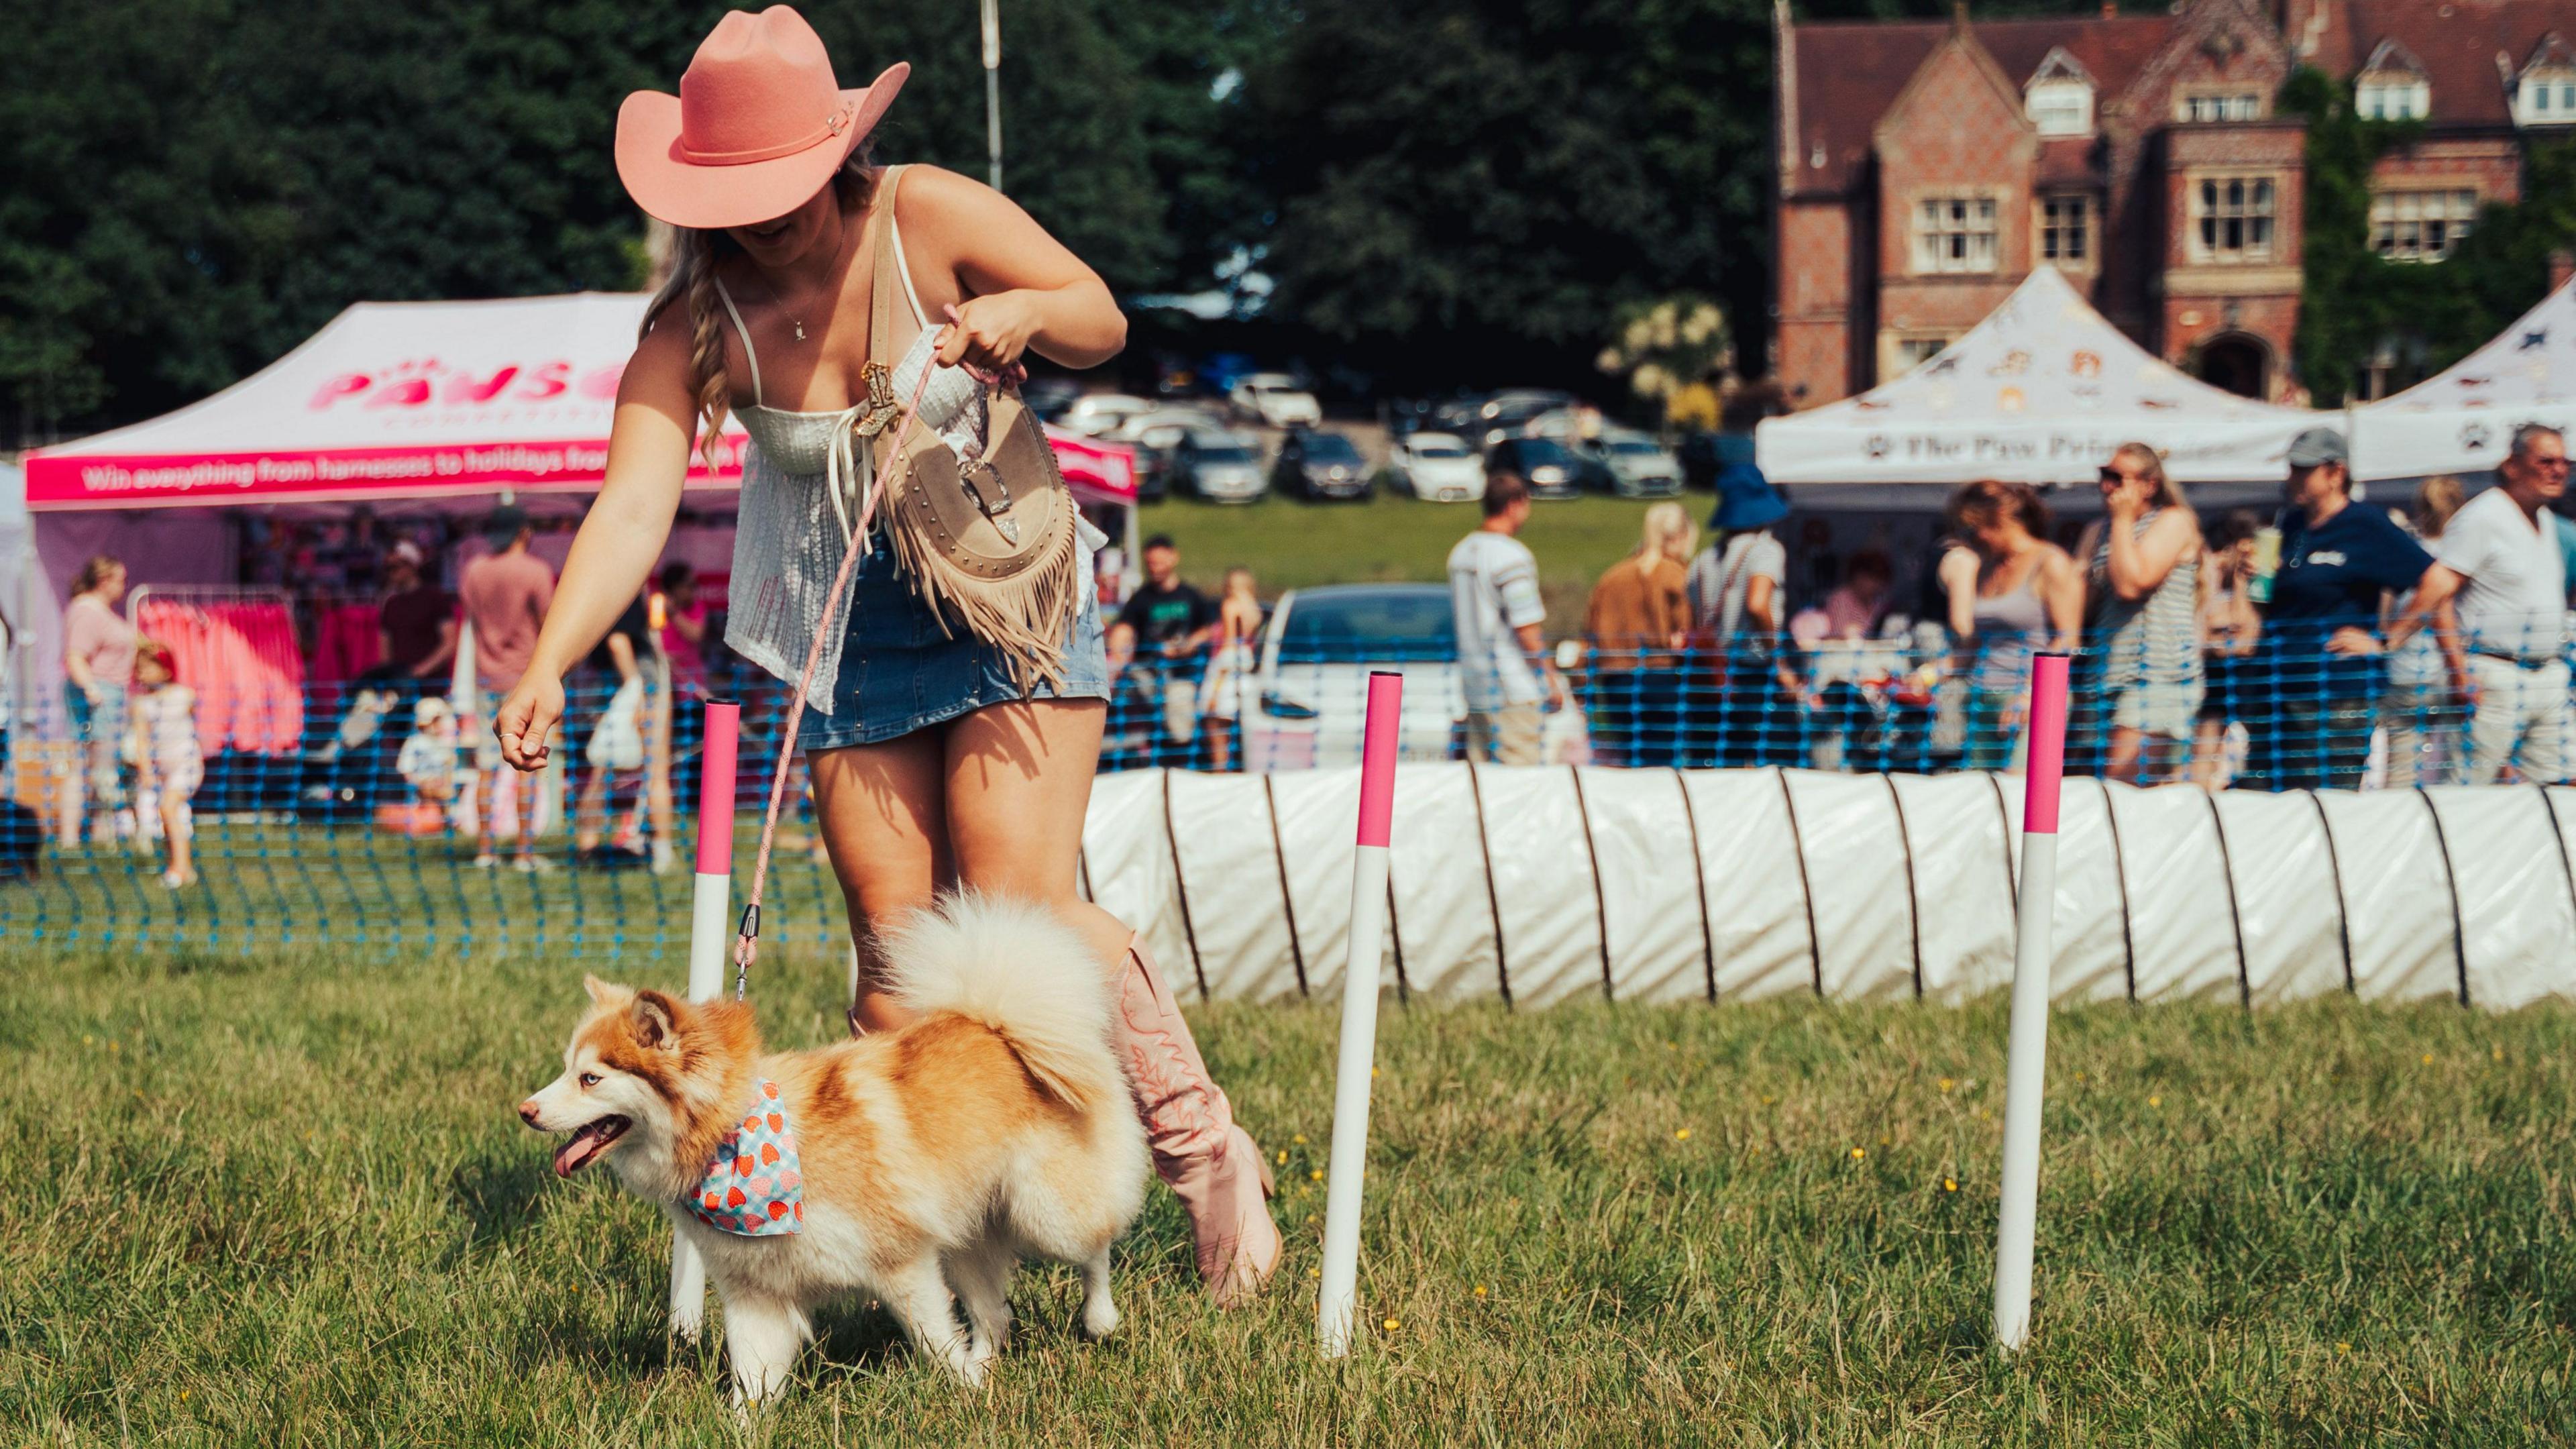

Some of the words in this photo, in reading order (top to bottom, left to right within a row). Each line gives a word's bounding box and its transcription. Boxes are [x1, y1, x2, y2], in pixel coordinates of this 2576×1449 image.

[1907, 434, 1962, 460] The
[1974, 433, 2035, 460] Paw
[81, 462, 131, 491] Win
[133, 460, 256, 490] everything
[256, 456, 315, 482] from
[316, 455, 433, 480] harnesses
[434, 451, 463, 476] to
[463, 445, 564, 476] holidays
